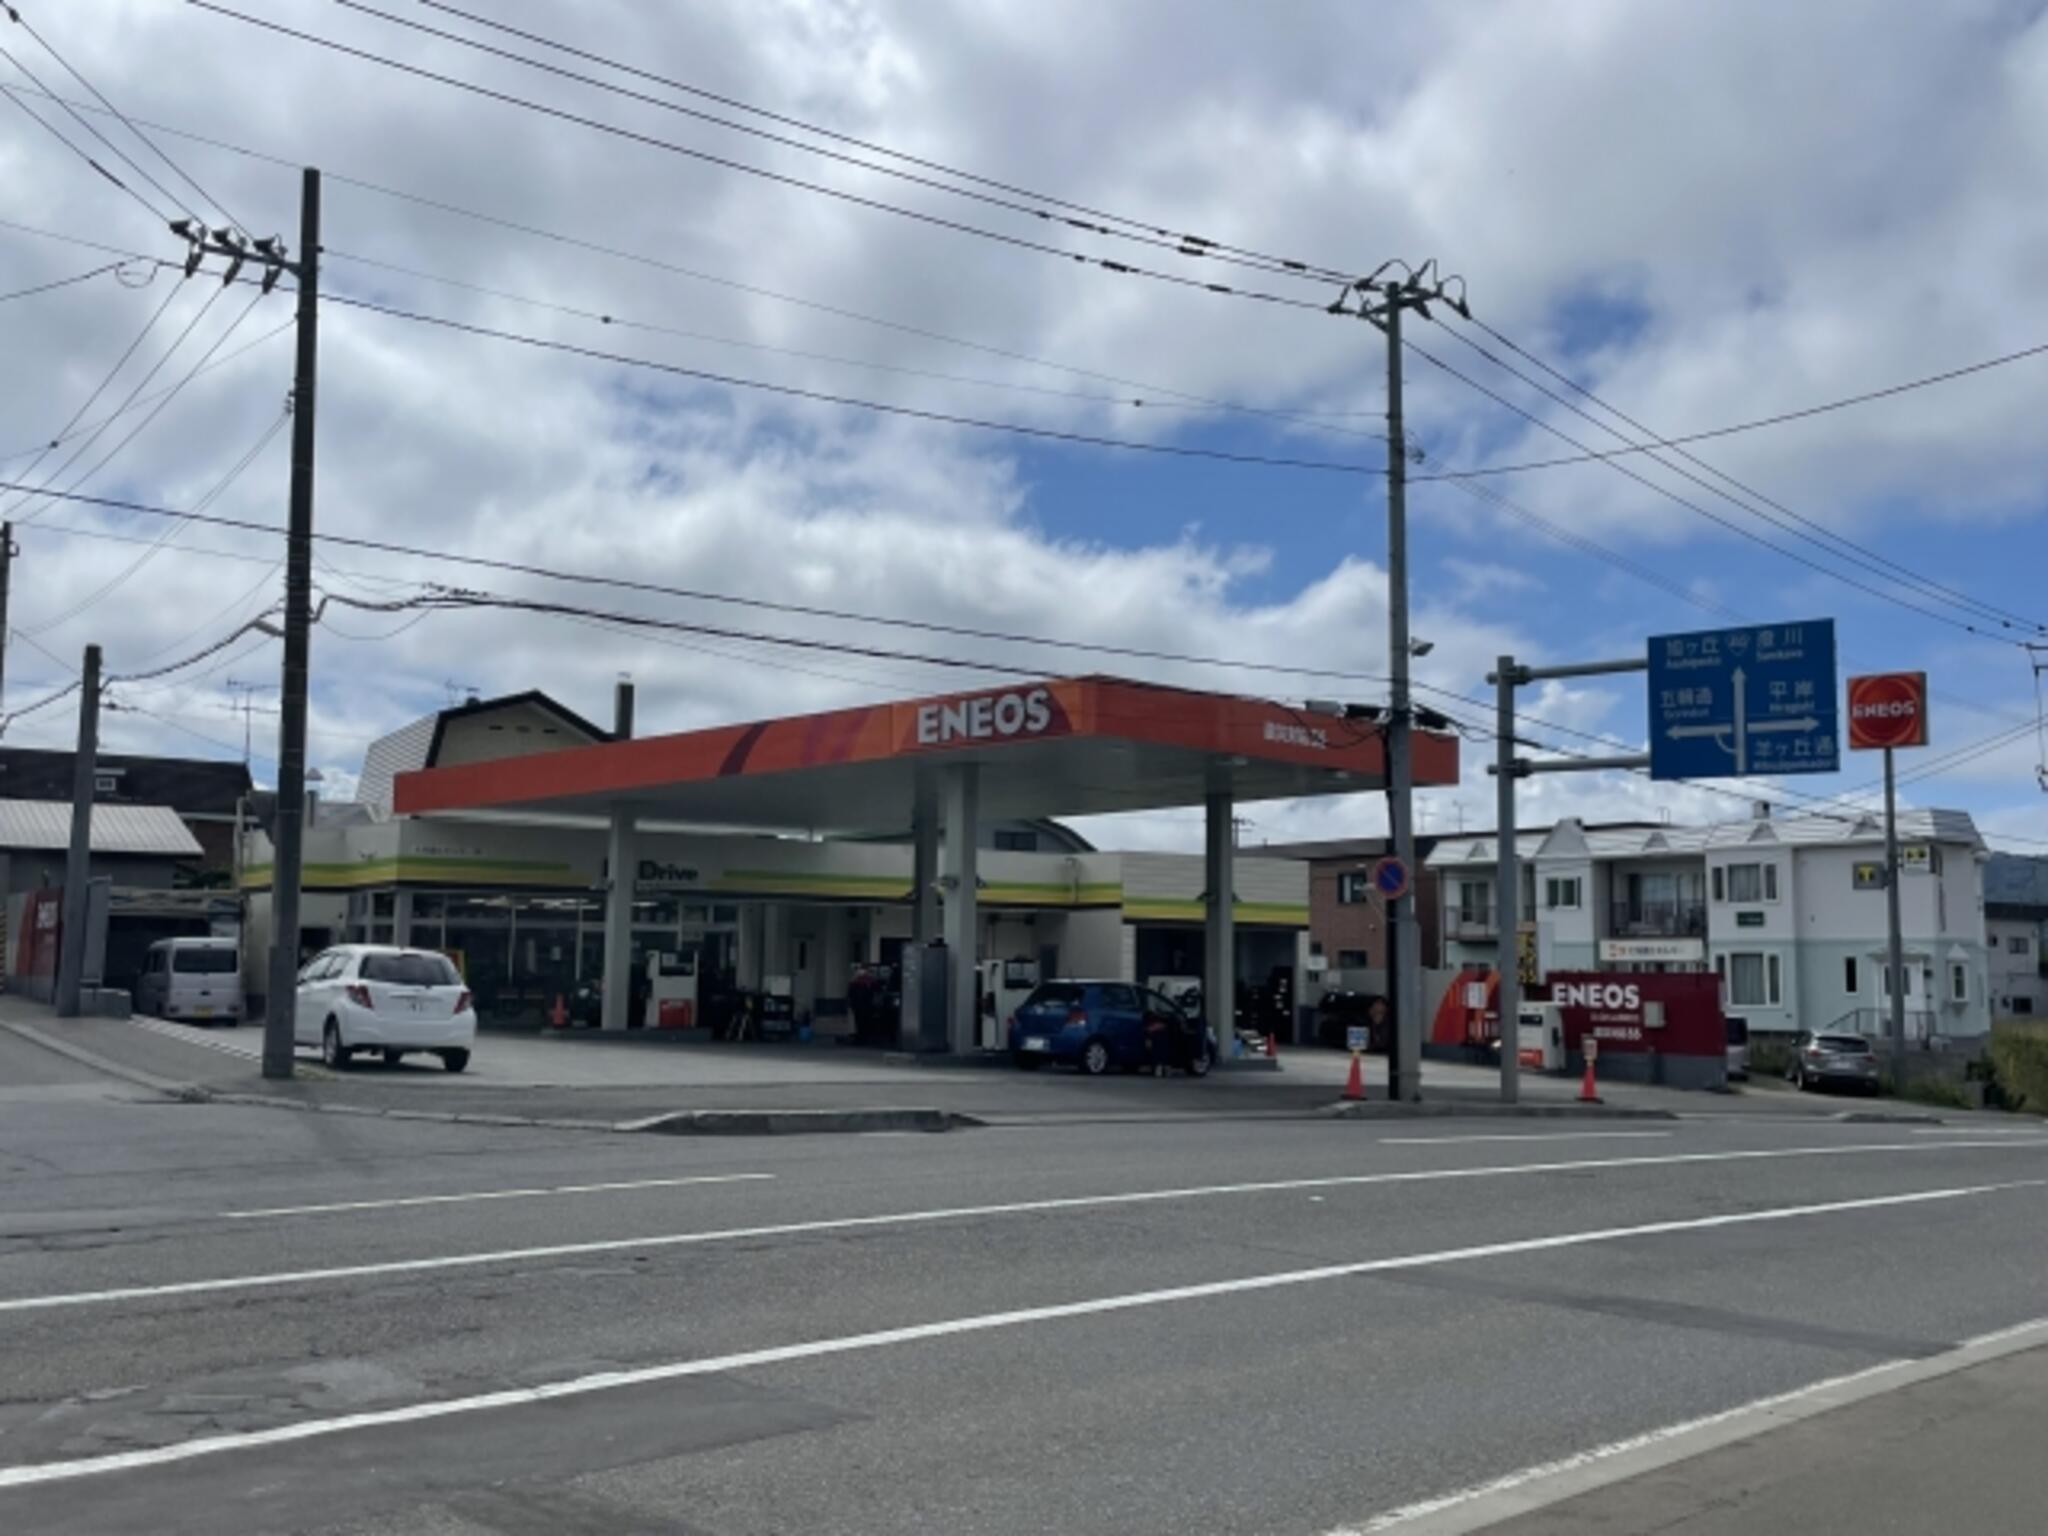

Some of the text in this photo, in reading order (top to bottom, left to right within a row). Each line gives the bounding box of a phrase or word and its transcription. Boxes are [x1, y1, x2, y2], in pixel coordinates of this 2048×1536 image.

[918, 689, 1049, 743] ENEOS
[1852, 700, 1915, 718] ENEOS
[1551, 983, 1640, 1009] ENEOS
